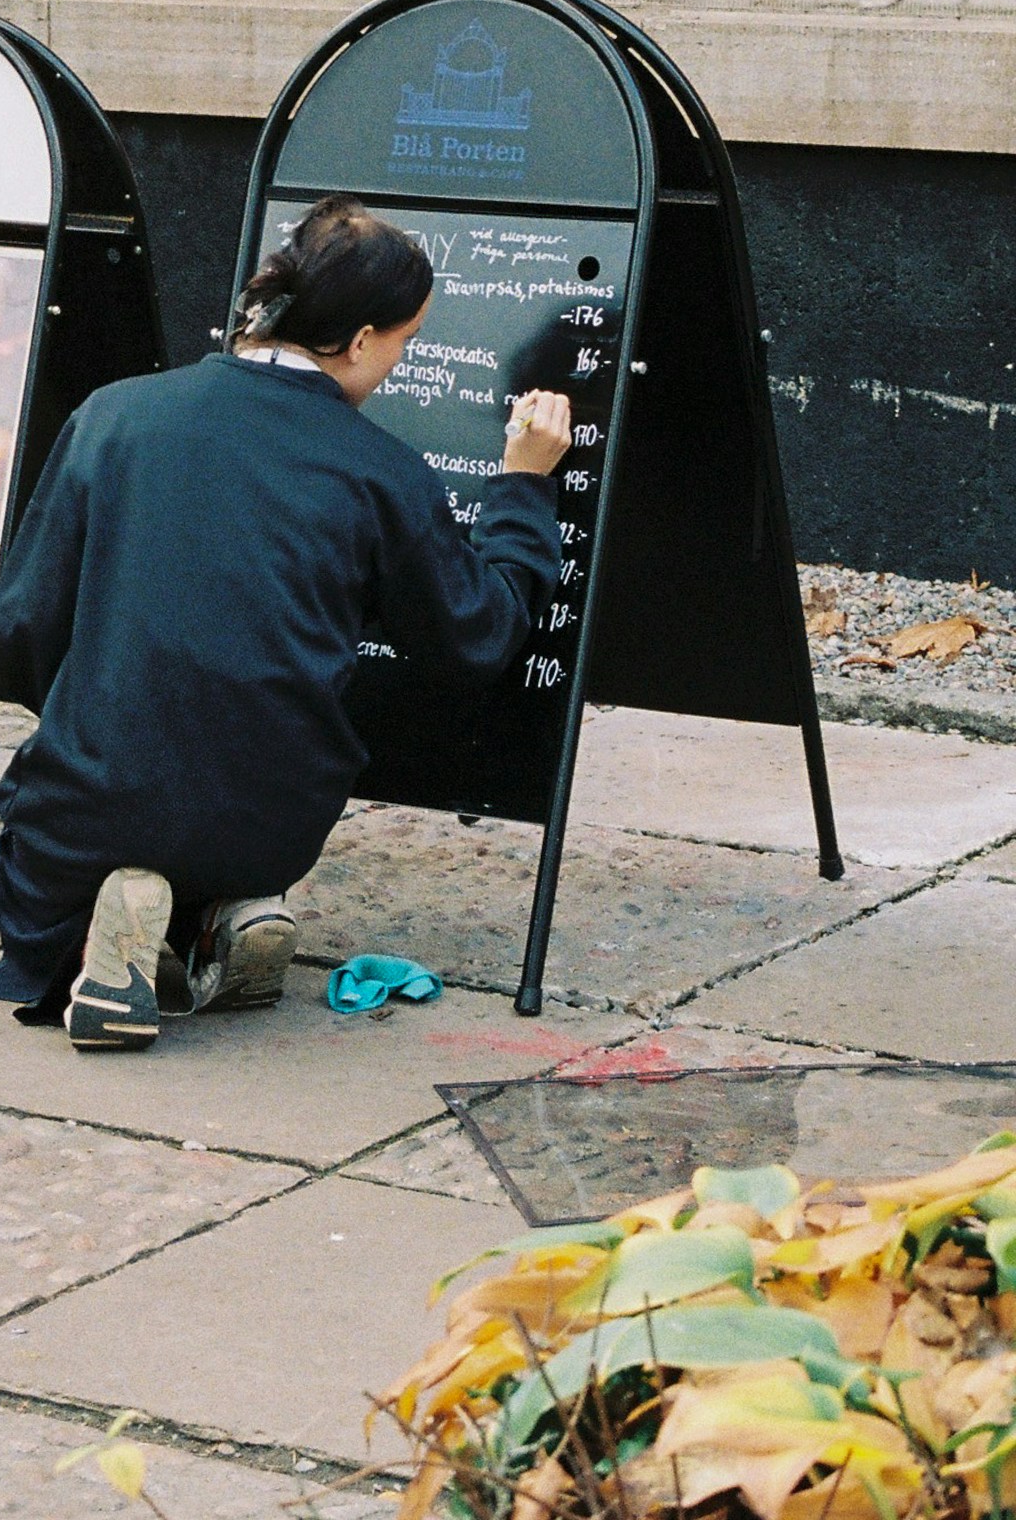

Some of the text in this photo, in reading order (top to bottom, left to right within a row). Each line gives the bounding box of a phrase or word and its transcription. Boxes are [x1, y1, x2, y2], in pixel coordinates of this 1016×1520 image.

[391, 132, 525, 162] Blå Porten
[387, 163, 476, 178] RESTAURANG
[403, 229, 458, 271] NY
[469, 227, 494, 240] vid
[470, 242, 571, 267] fråga personal
[527, 277, 615, 300] potatismos
[459, 388, 495, 404] med
